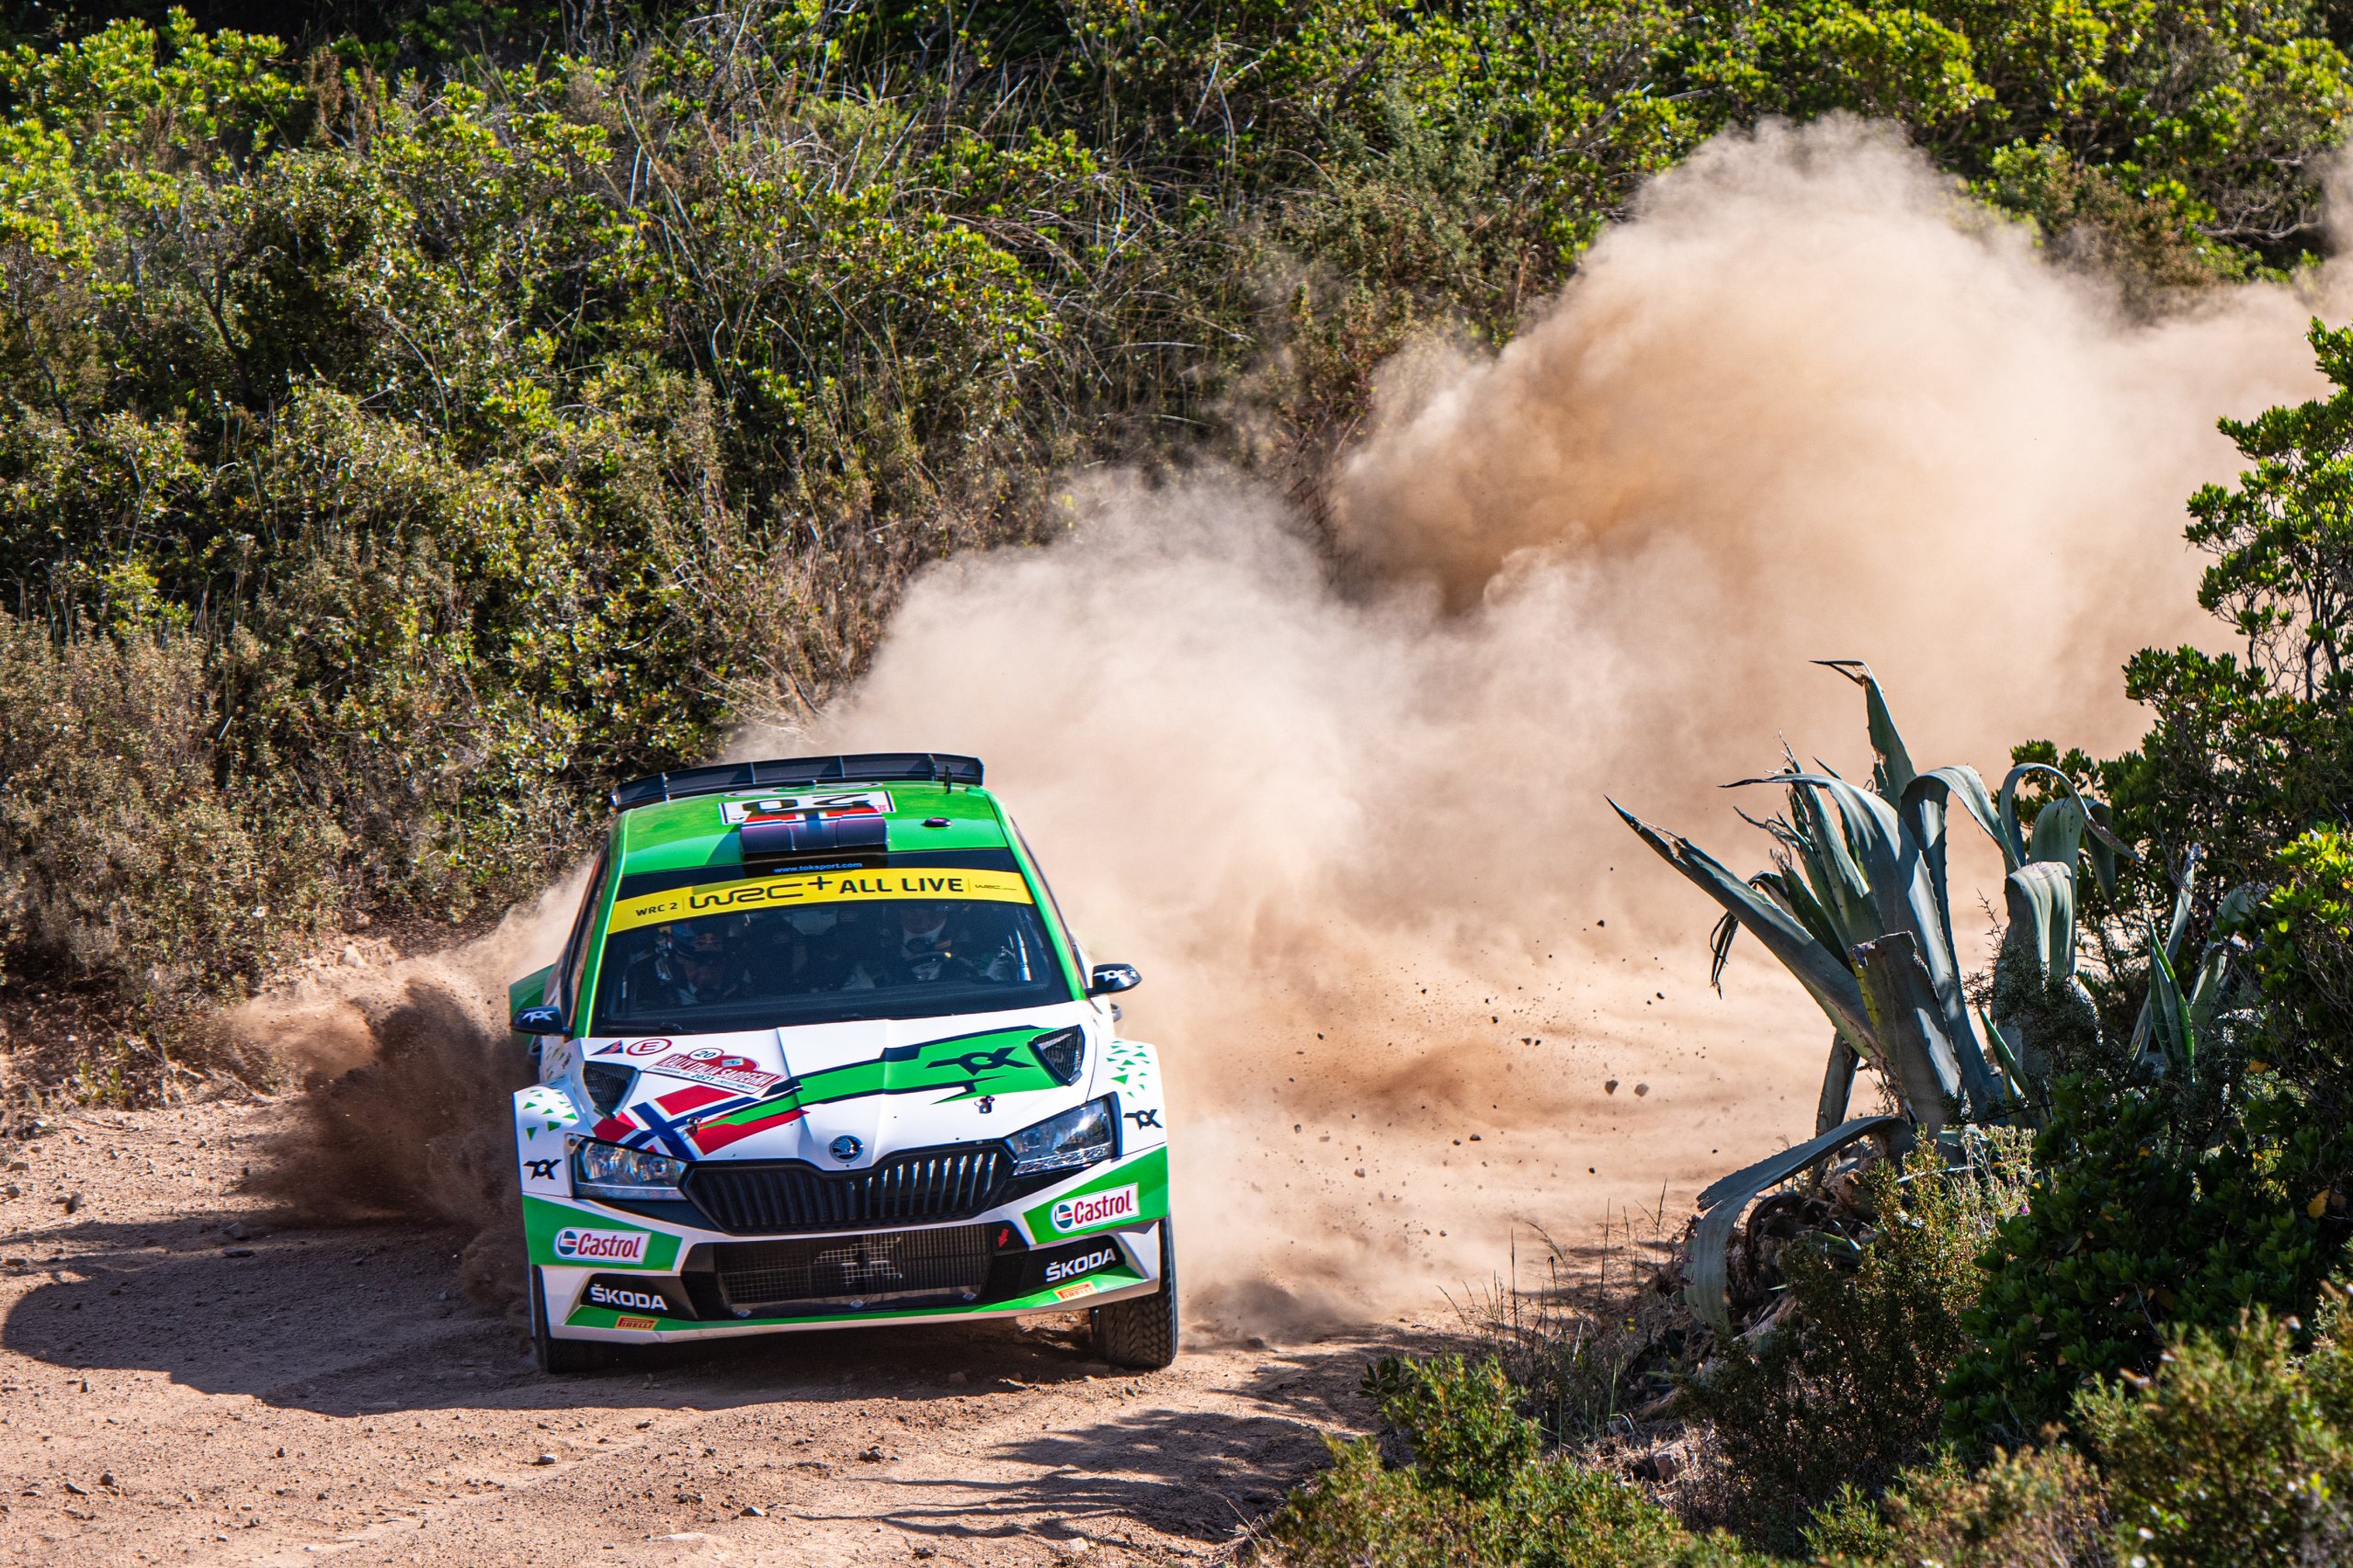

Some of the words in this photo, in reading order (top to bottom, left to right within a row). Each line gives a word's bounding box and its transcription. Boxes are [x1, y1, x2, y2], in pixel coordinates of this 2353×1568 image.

[773, 861, 863, 873] www.toksport.com
[839, 879, 892, 894] ALL
[901, 878, 964, 892] LIVE
[635, 903, 665, 916] WRC
[669, 902, 678, 911] 2
[638, 1041, 660, 1052] E
[694, 1050, 717, 1059] 20
[657, 1054, 698, 1069] RALLY
[684, 1062, 725, 1075] ITALIA
[712, 1069, 775, 1086] SARDEGNA
[690, 1073, 715, 1083] 2021
[1074, 1189, 1133, 1224] Castrol
[576, 1233, 642, 1258] Castrol
[1045, 1247, 1116, 1282] ŠKODA
[590, 1283, 669, 1311] ŠKODA
[1058, 1283, 1094, 1299] PIRELLI
[617, 1317, 657, 1329] PIRELLI
